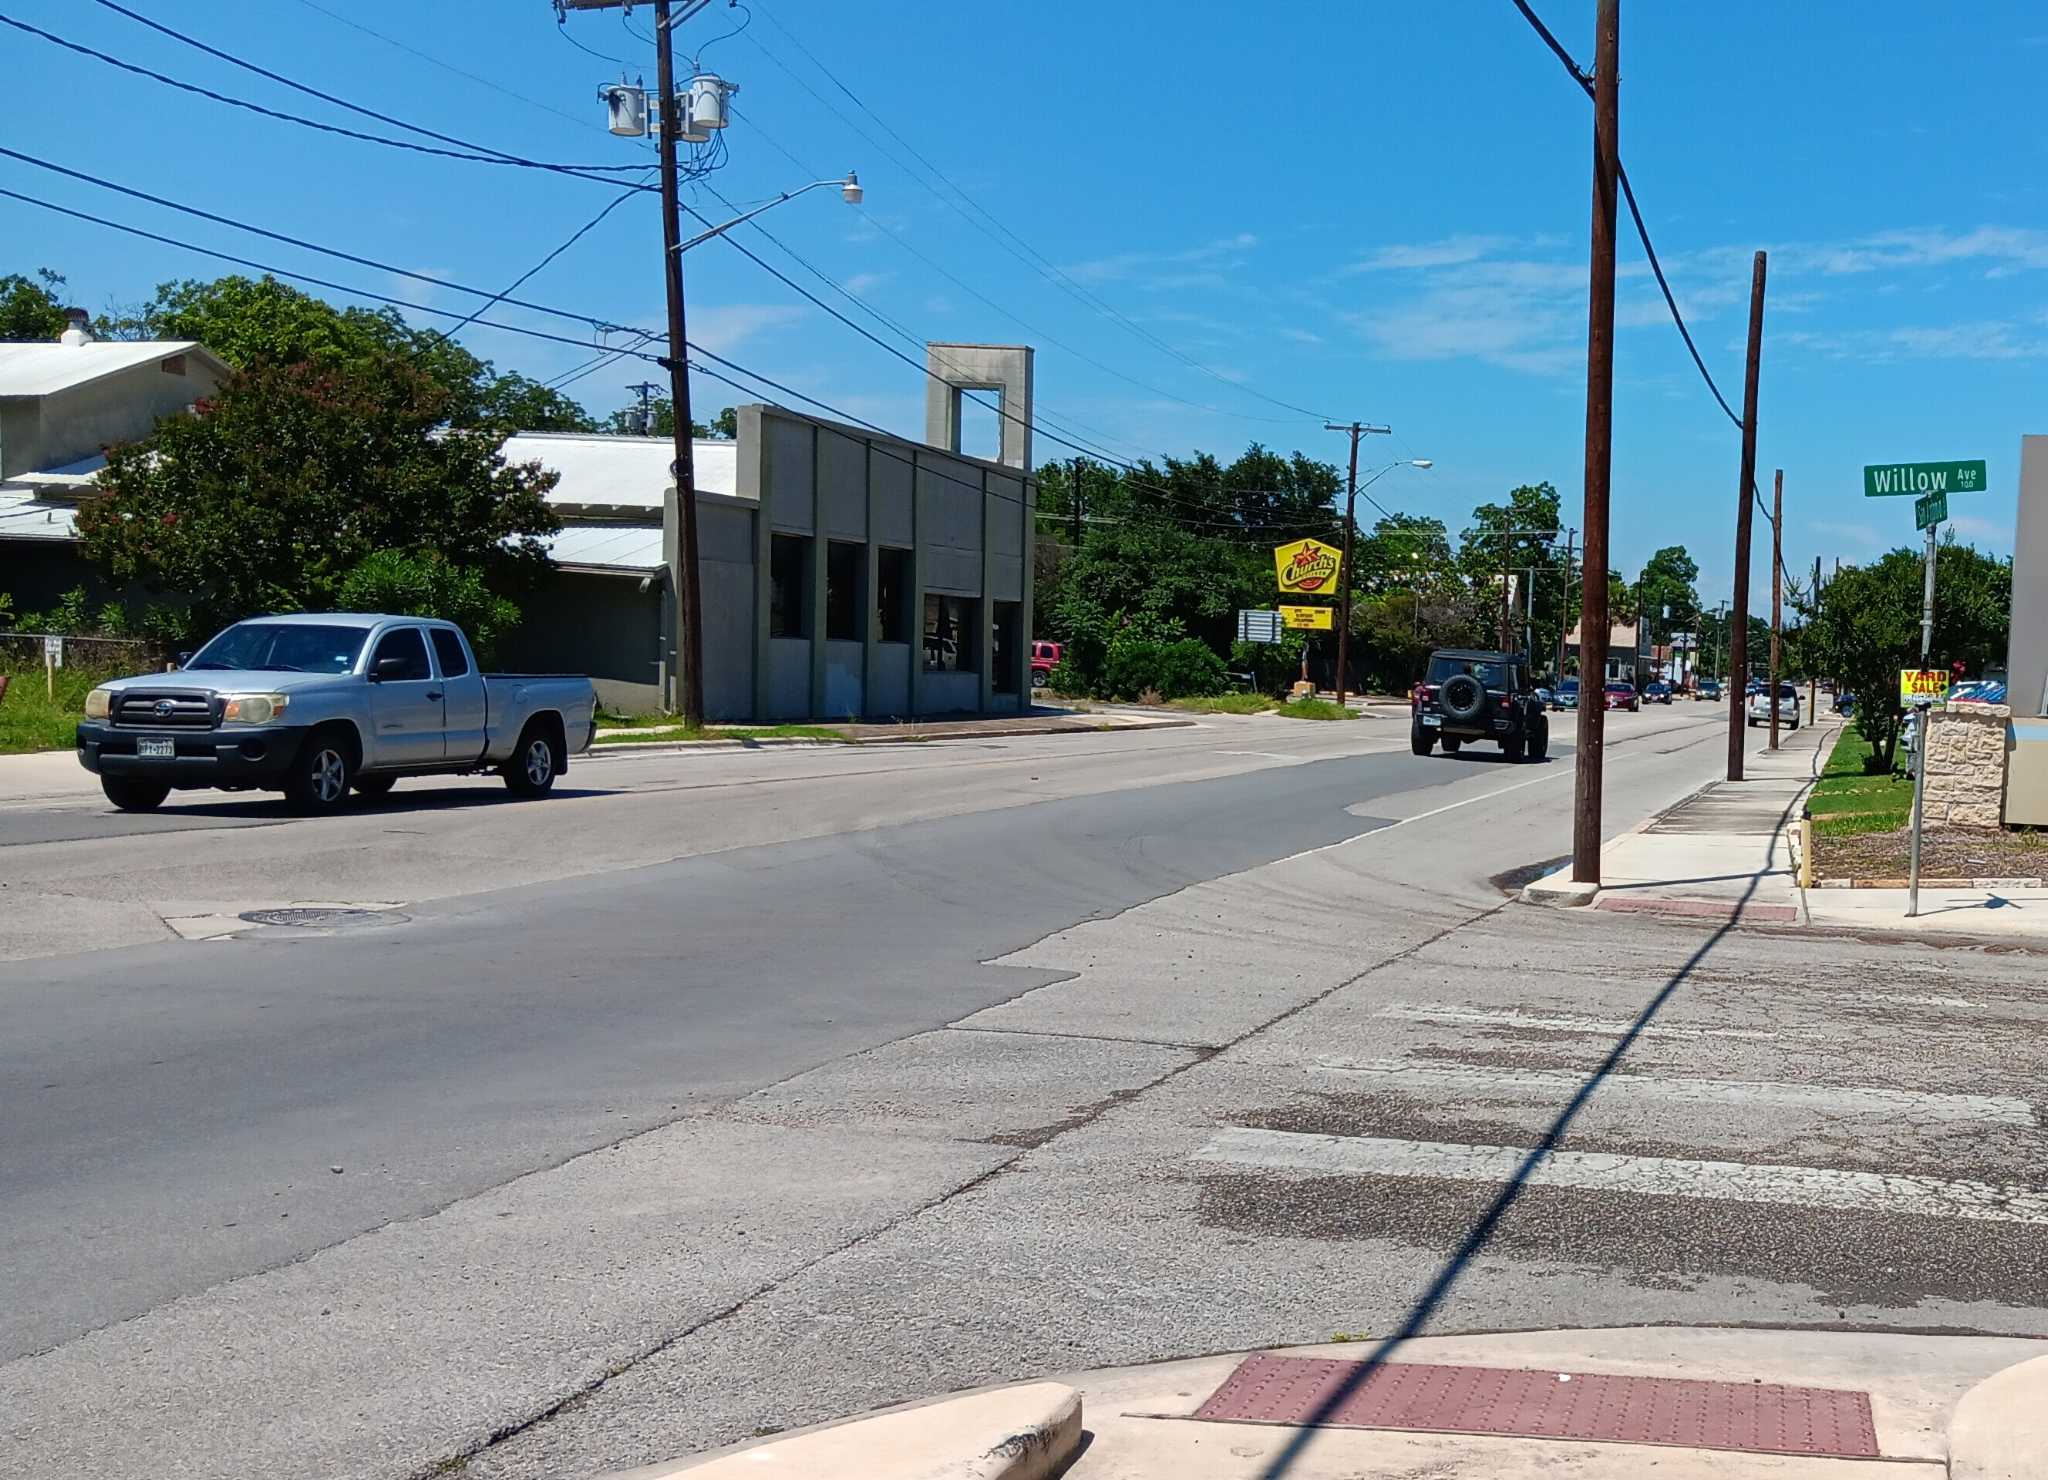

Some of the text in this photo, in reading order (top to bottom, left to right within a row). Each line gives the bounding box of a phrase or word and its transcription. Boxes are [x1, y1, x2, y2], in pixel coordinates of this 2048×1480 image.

[1874, 467, 1977, 493] Willow Ave
[1281, 555, 1335, 585] Church's
[1904, 671, 1947, 682] YARD
[1911, 682, 1940, 693] SALE
